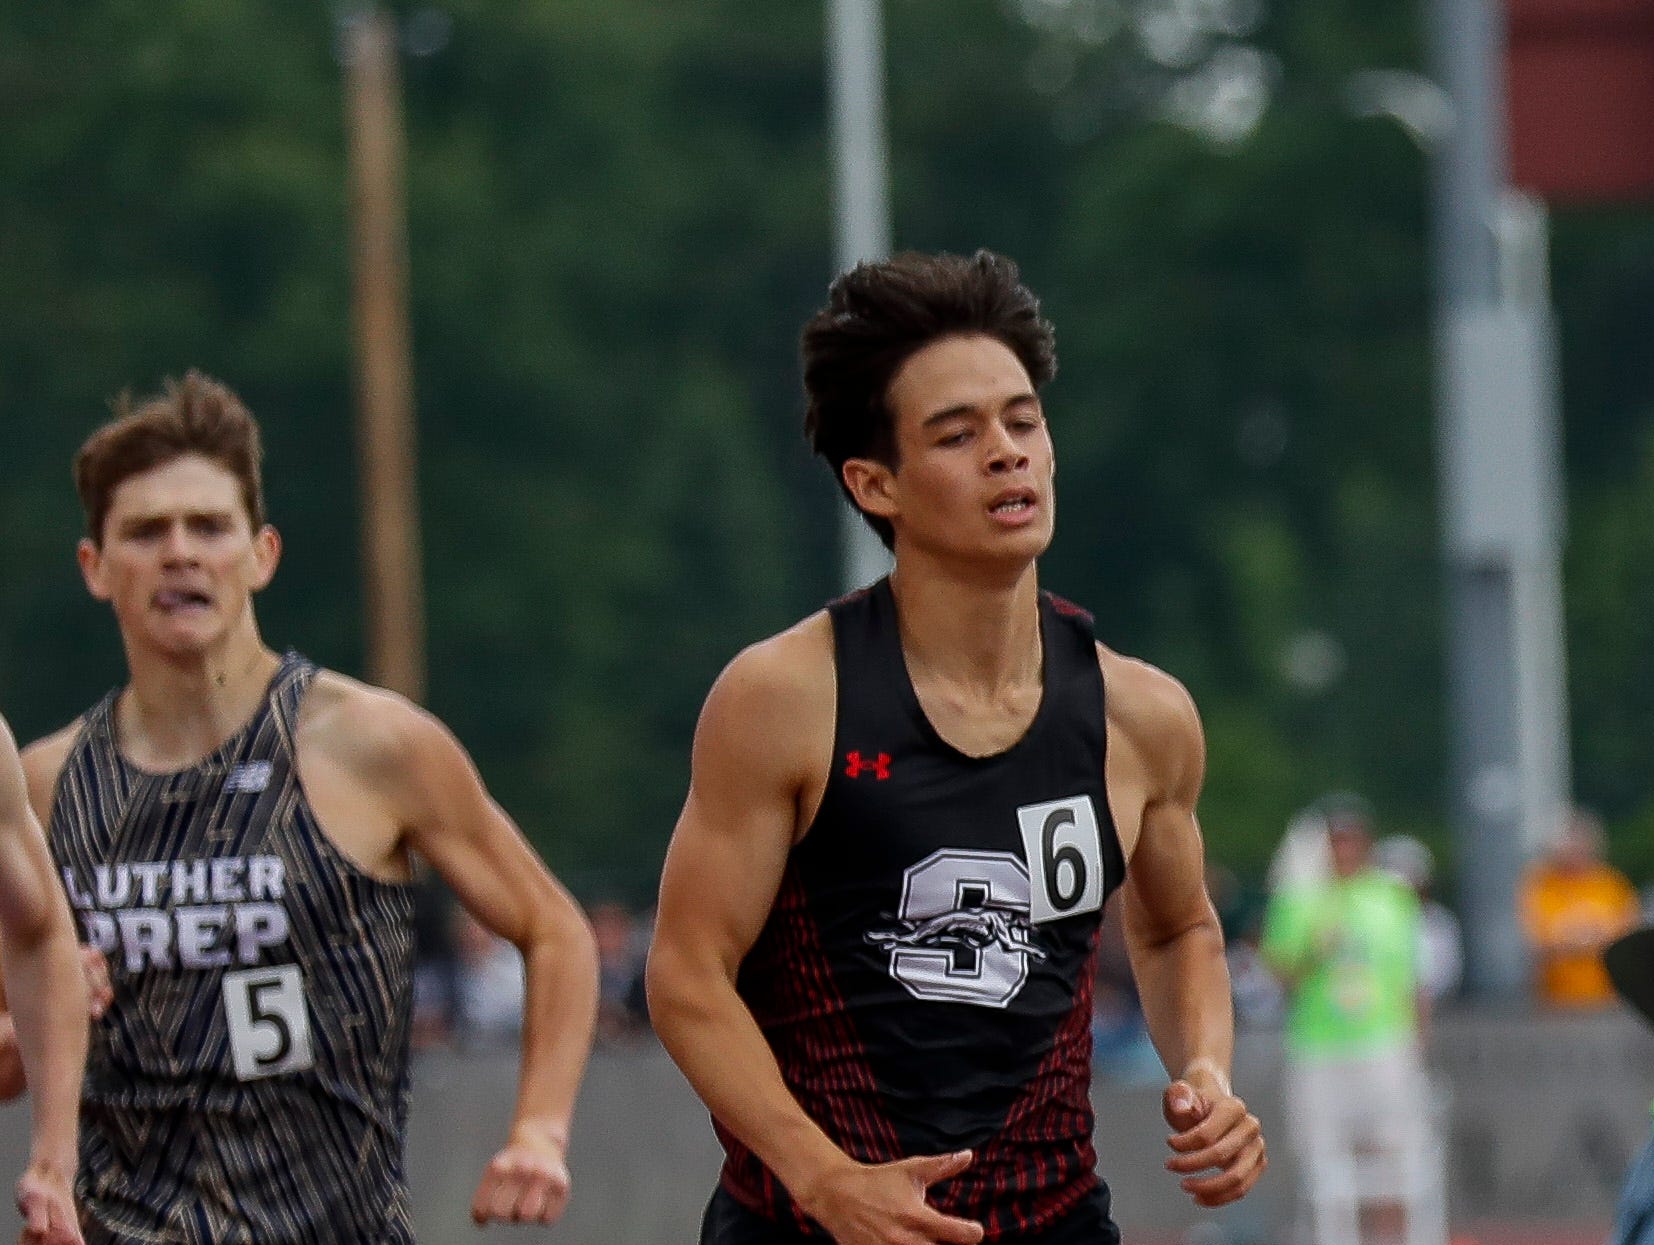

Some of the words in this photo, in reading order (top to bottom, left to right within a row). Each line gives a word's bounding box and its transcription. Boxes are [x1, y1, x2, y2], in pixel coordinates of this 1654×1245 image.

[62, 854, 287, 909] LUTHER
[1042, 808, 1087, 911] 6
[80, 901, 291, 974] PREP
[889, 847, 1032, 1009] S
[244, 978, 292, 1066] 5
